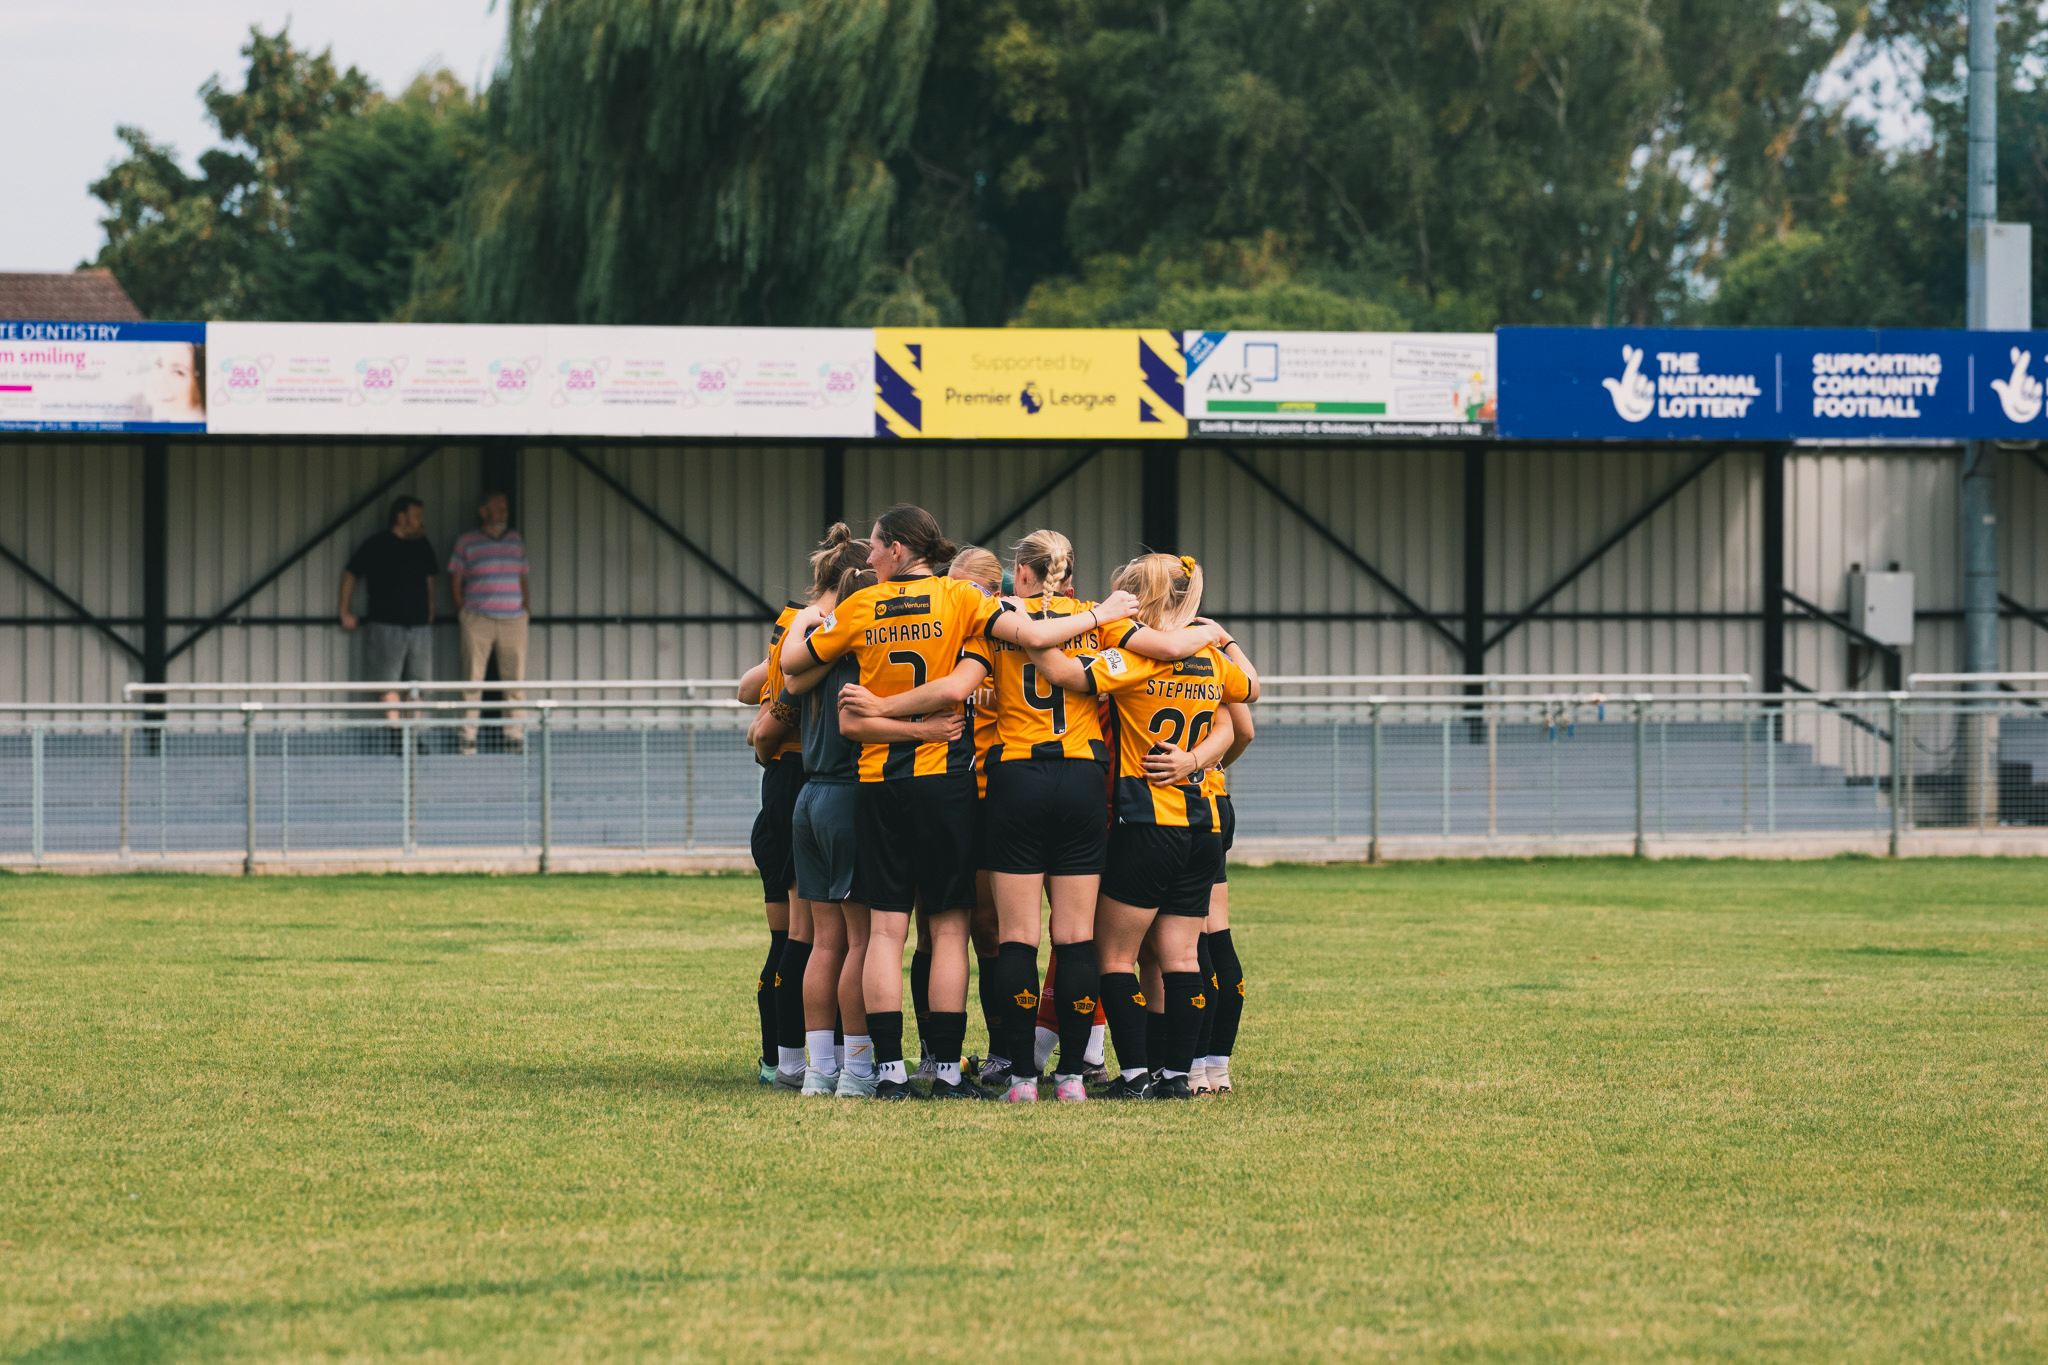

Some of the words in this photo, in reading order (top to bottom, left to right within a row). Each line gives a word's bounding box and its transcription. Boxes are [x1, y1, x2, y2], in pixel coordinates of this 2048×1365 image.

[22, 324, 121, 340] DENTISTRY
[20, 346, 86, 371] smiling
[971, 353, 1066, 371] Supported
[1069, 352, 1092, 373] by
[1656, 352, 1700, 374] THE
[1812, 353, 1942, 375] SUPPORTING
[227, 377, 260, 388] GOLF
[363, 378, 394, 389] GOLF
[496, 379, 527, 390] GOLF
[565, 380, 596, 391] GOLF
[697, 381, 727, 391] GOLF
[826, 382, 856, 392] GOLF
[1207, 373, 1252, 394] AVS
[1658, 375, 1762, 396] NATIONAL
[1812, 375, 1939, 396] COMMUNITY
[945, 387, 1012, 404] Premier
[1049, 388, 1116, 410] League
[1658, 397, 1755, 418] LOTTERY
[1813, 396, 1921, 418] FOOTBALL
[1232, 421, 1257, 433] Road
[1373, 423, 1438, 437] Peterborough
[865, 621, 943, 646] RICHARDS
[1022, 661, 1067, 735] 4
